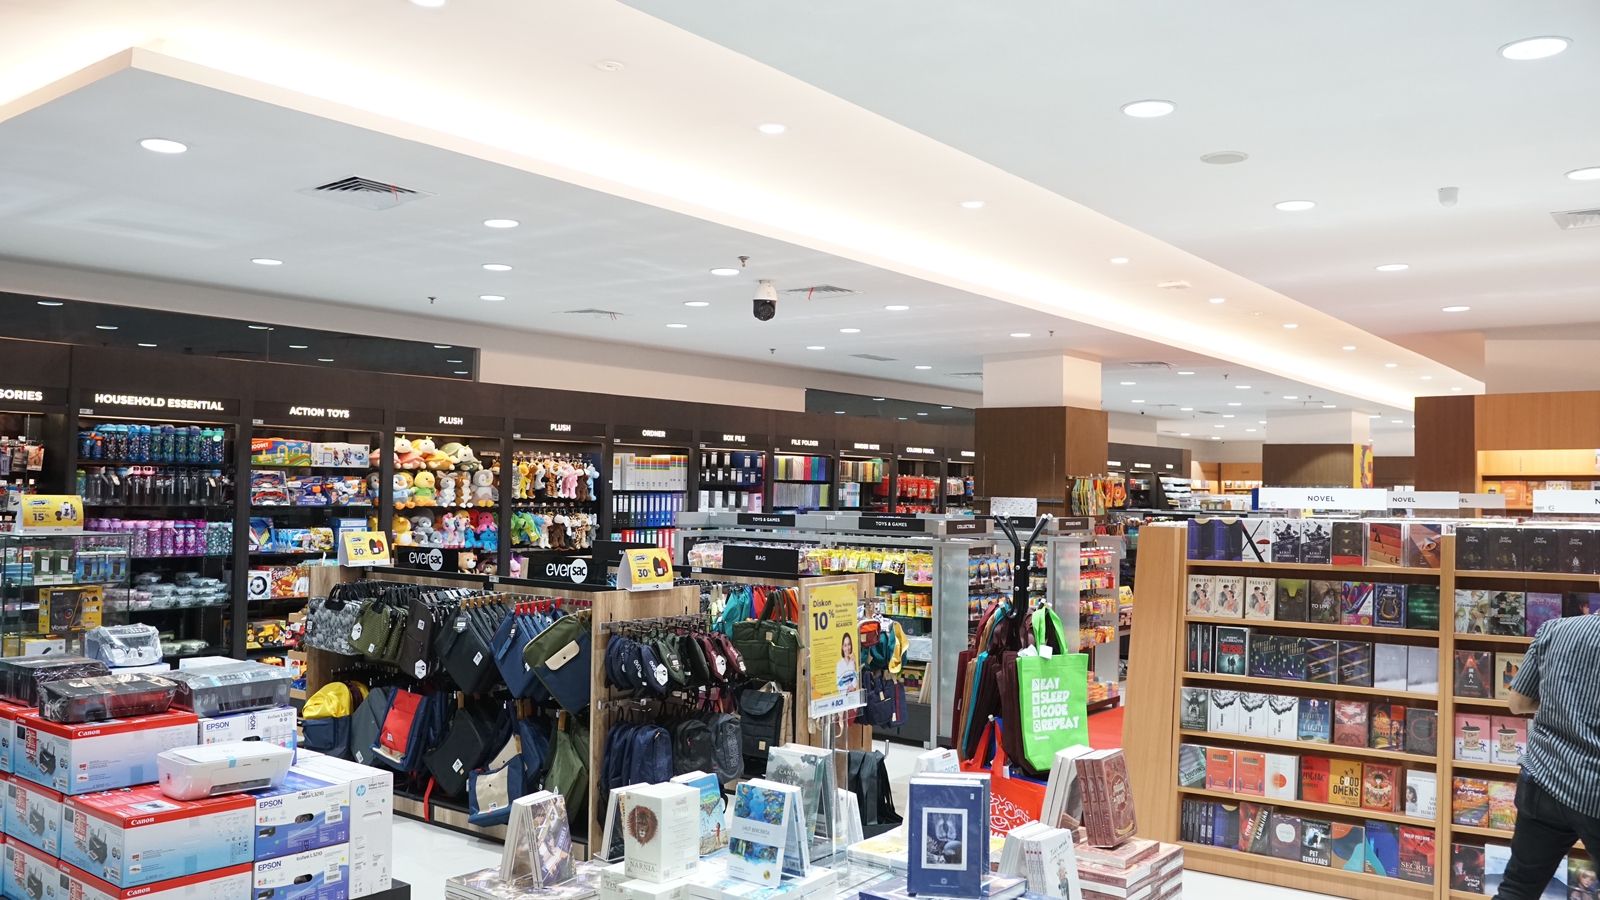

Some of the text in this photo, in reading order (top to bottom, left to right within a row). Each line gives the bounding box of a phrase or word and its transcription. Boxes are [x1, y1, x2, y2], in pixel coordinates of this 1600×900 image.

[95, 393, 224, 411] HOUSEHOLD ESSENTIAL
[289, 406, 350, 418] ACTION TOYS
[438, 416, 463, 425] PLUSH
[550, 424, 571, 432] PLUSH
[642, 429, 666, 438] ORDNER
[723, 434, 746, 443] BOX FILE
[545, 561, 587, 579] eversac
[813, 600, 832, 608] Diskon
[1040, 678, 1060, 691] EAT
[1040, 690, 1070, 703] SLEEP
[206, 721, 230, 730] EPSON
[1041, 716, 1080, 732] REPEAT
[77, 729, 101, 737] Canon
[1339, 776, 1359, 787] GOOD
[1333, 785, 1359, 797] OMENS
[259, 799, 283, 809] EPSON
[131, 817, 155, 826] Canon
[1309, 849, 1318, 857] PET
[257, 860, 282, 871] EPSON
[630, 860, 656, 873] NARNIA
[1400, 861, 1432, 873] SECRET
[126, 887, 151, 896] Canon
